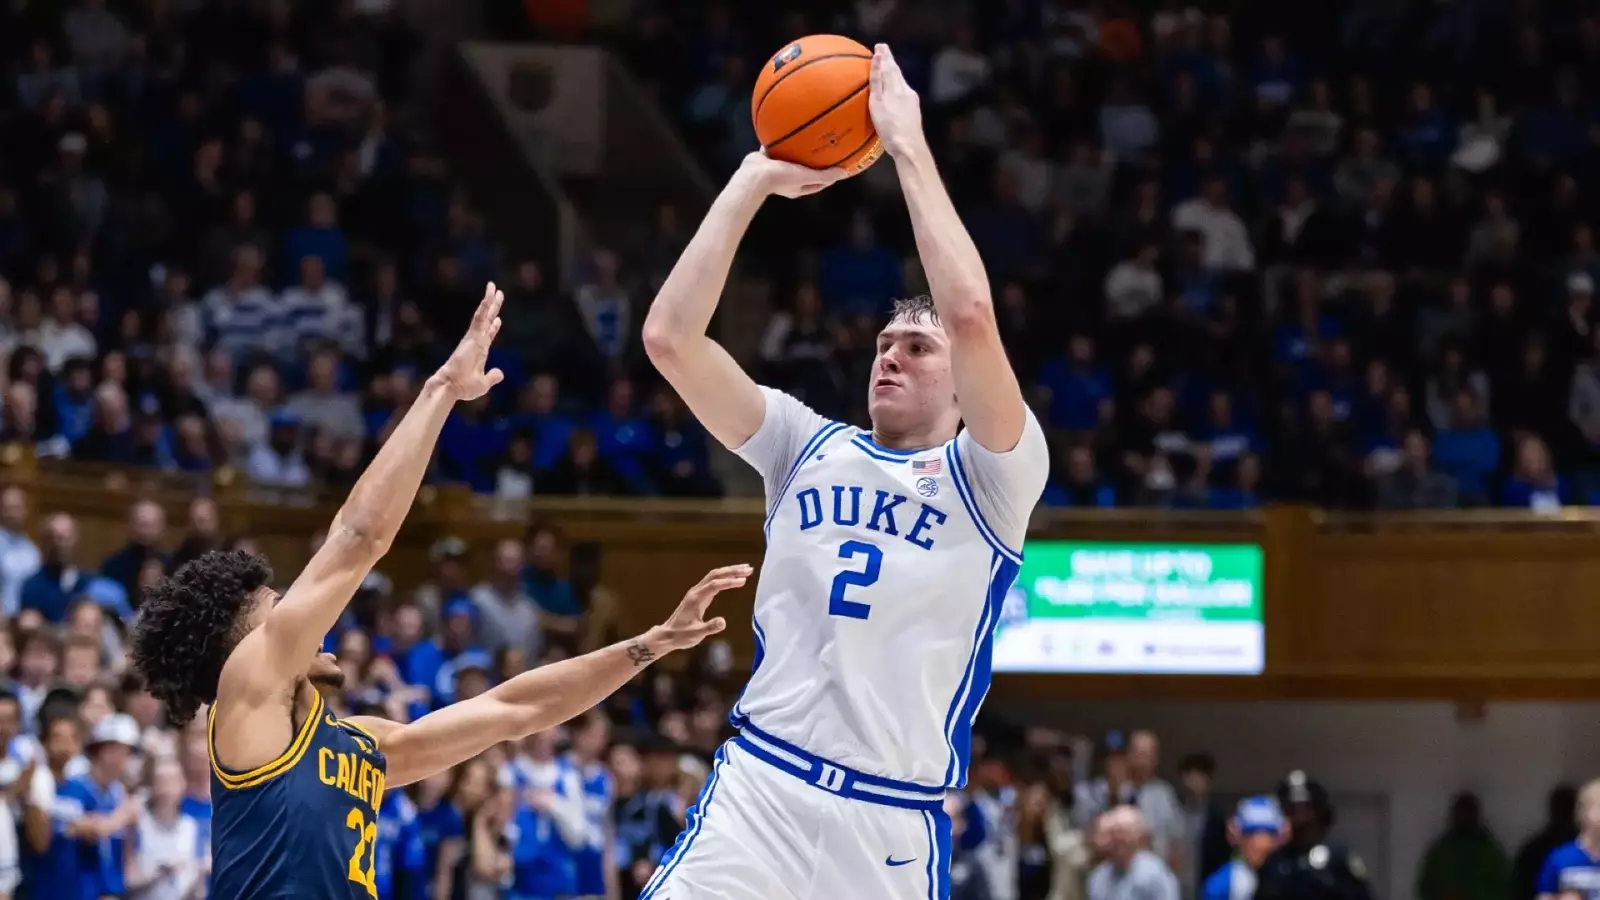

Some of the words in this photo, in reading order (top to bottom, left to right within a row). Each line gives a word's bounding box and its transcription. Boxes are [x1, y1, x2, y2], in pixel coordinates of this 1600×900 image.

[796, 486, 948, 550] DUKE
[828, 539, 884, 620] 2
[815, 762, 846, 792] D
